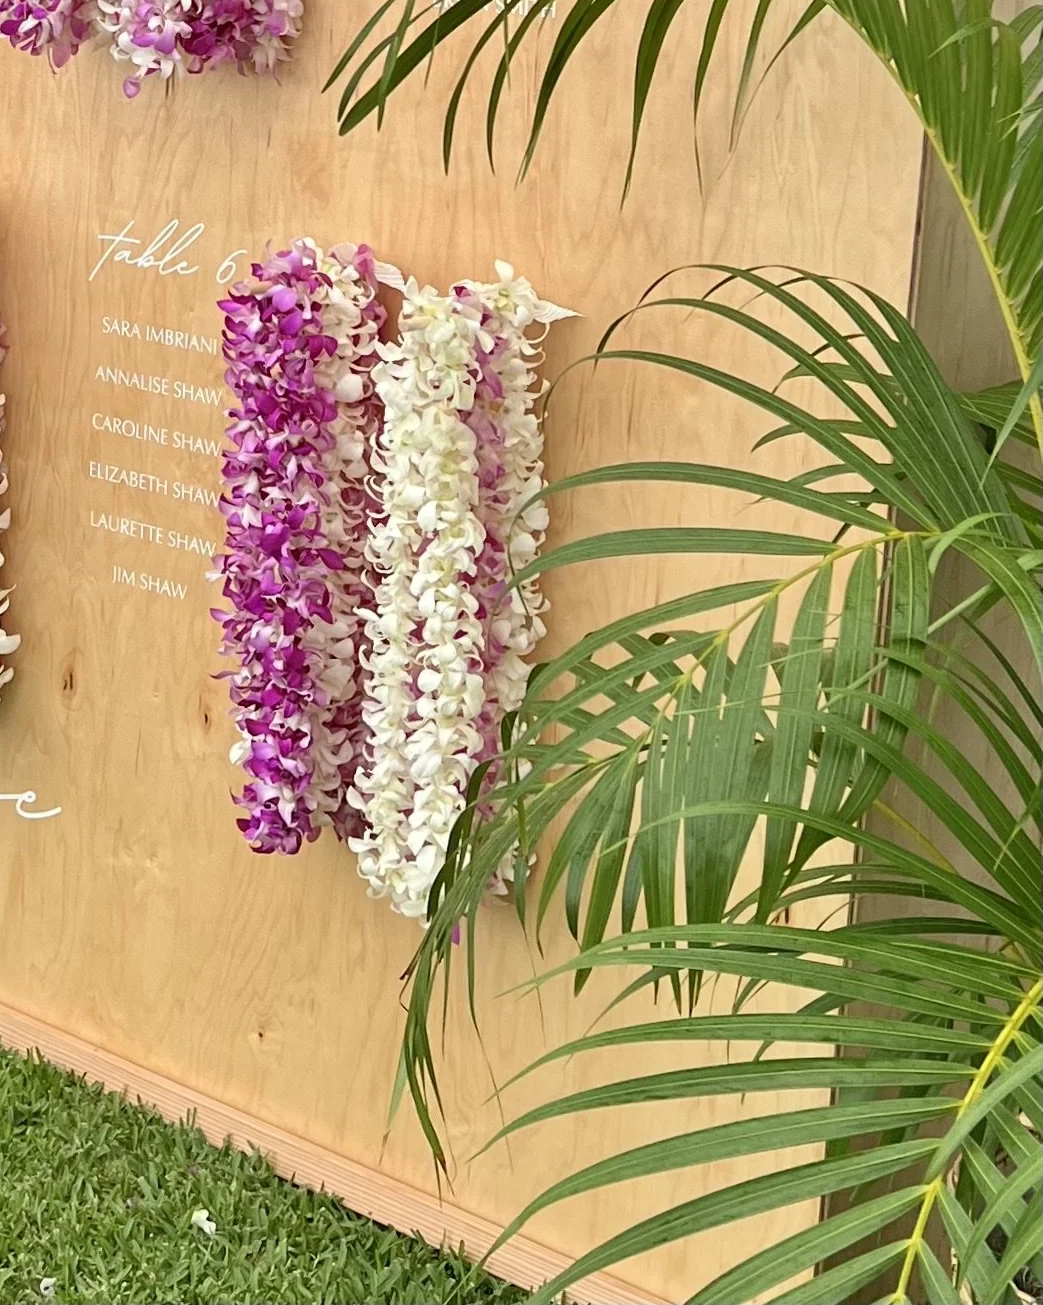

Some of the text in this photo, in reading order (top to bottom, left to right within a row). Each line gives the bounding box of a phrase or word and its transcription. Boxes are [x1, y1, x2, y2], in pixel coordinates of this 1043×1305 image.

[88, 219, 248, 284] table 6
[102, 316, 218, 355] SARA IMBRIANI
[94, 365, 223, 406] ANNALISE SHAW
[91, 413, 221, 457] CAROLINE SHAW
[89, 461, 220, 508] ELIZABETH SHAW
[90, 510, 216, 557] LAURETTE SHAW
[112, 565, 188, 601] JIM SHAW
